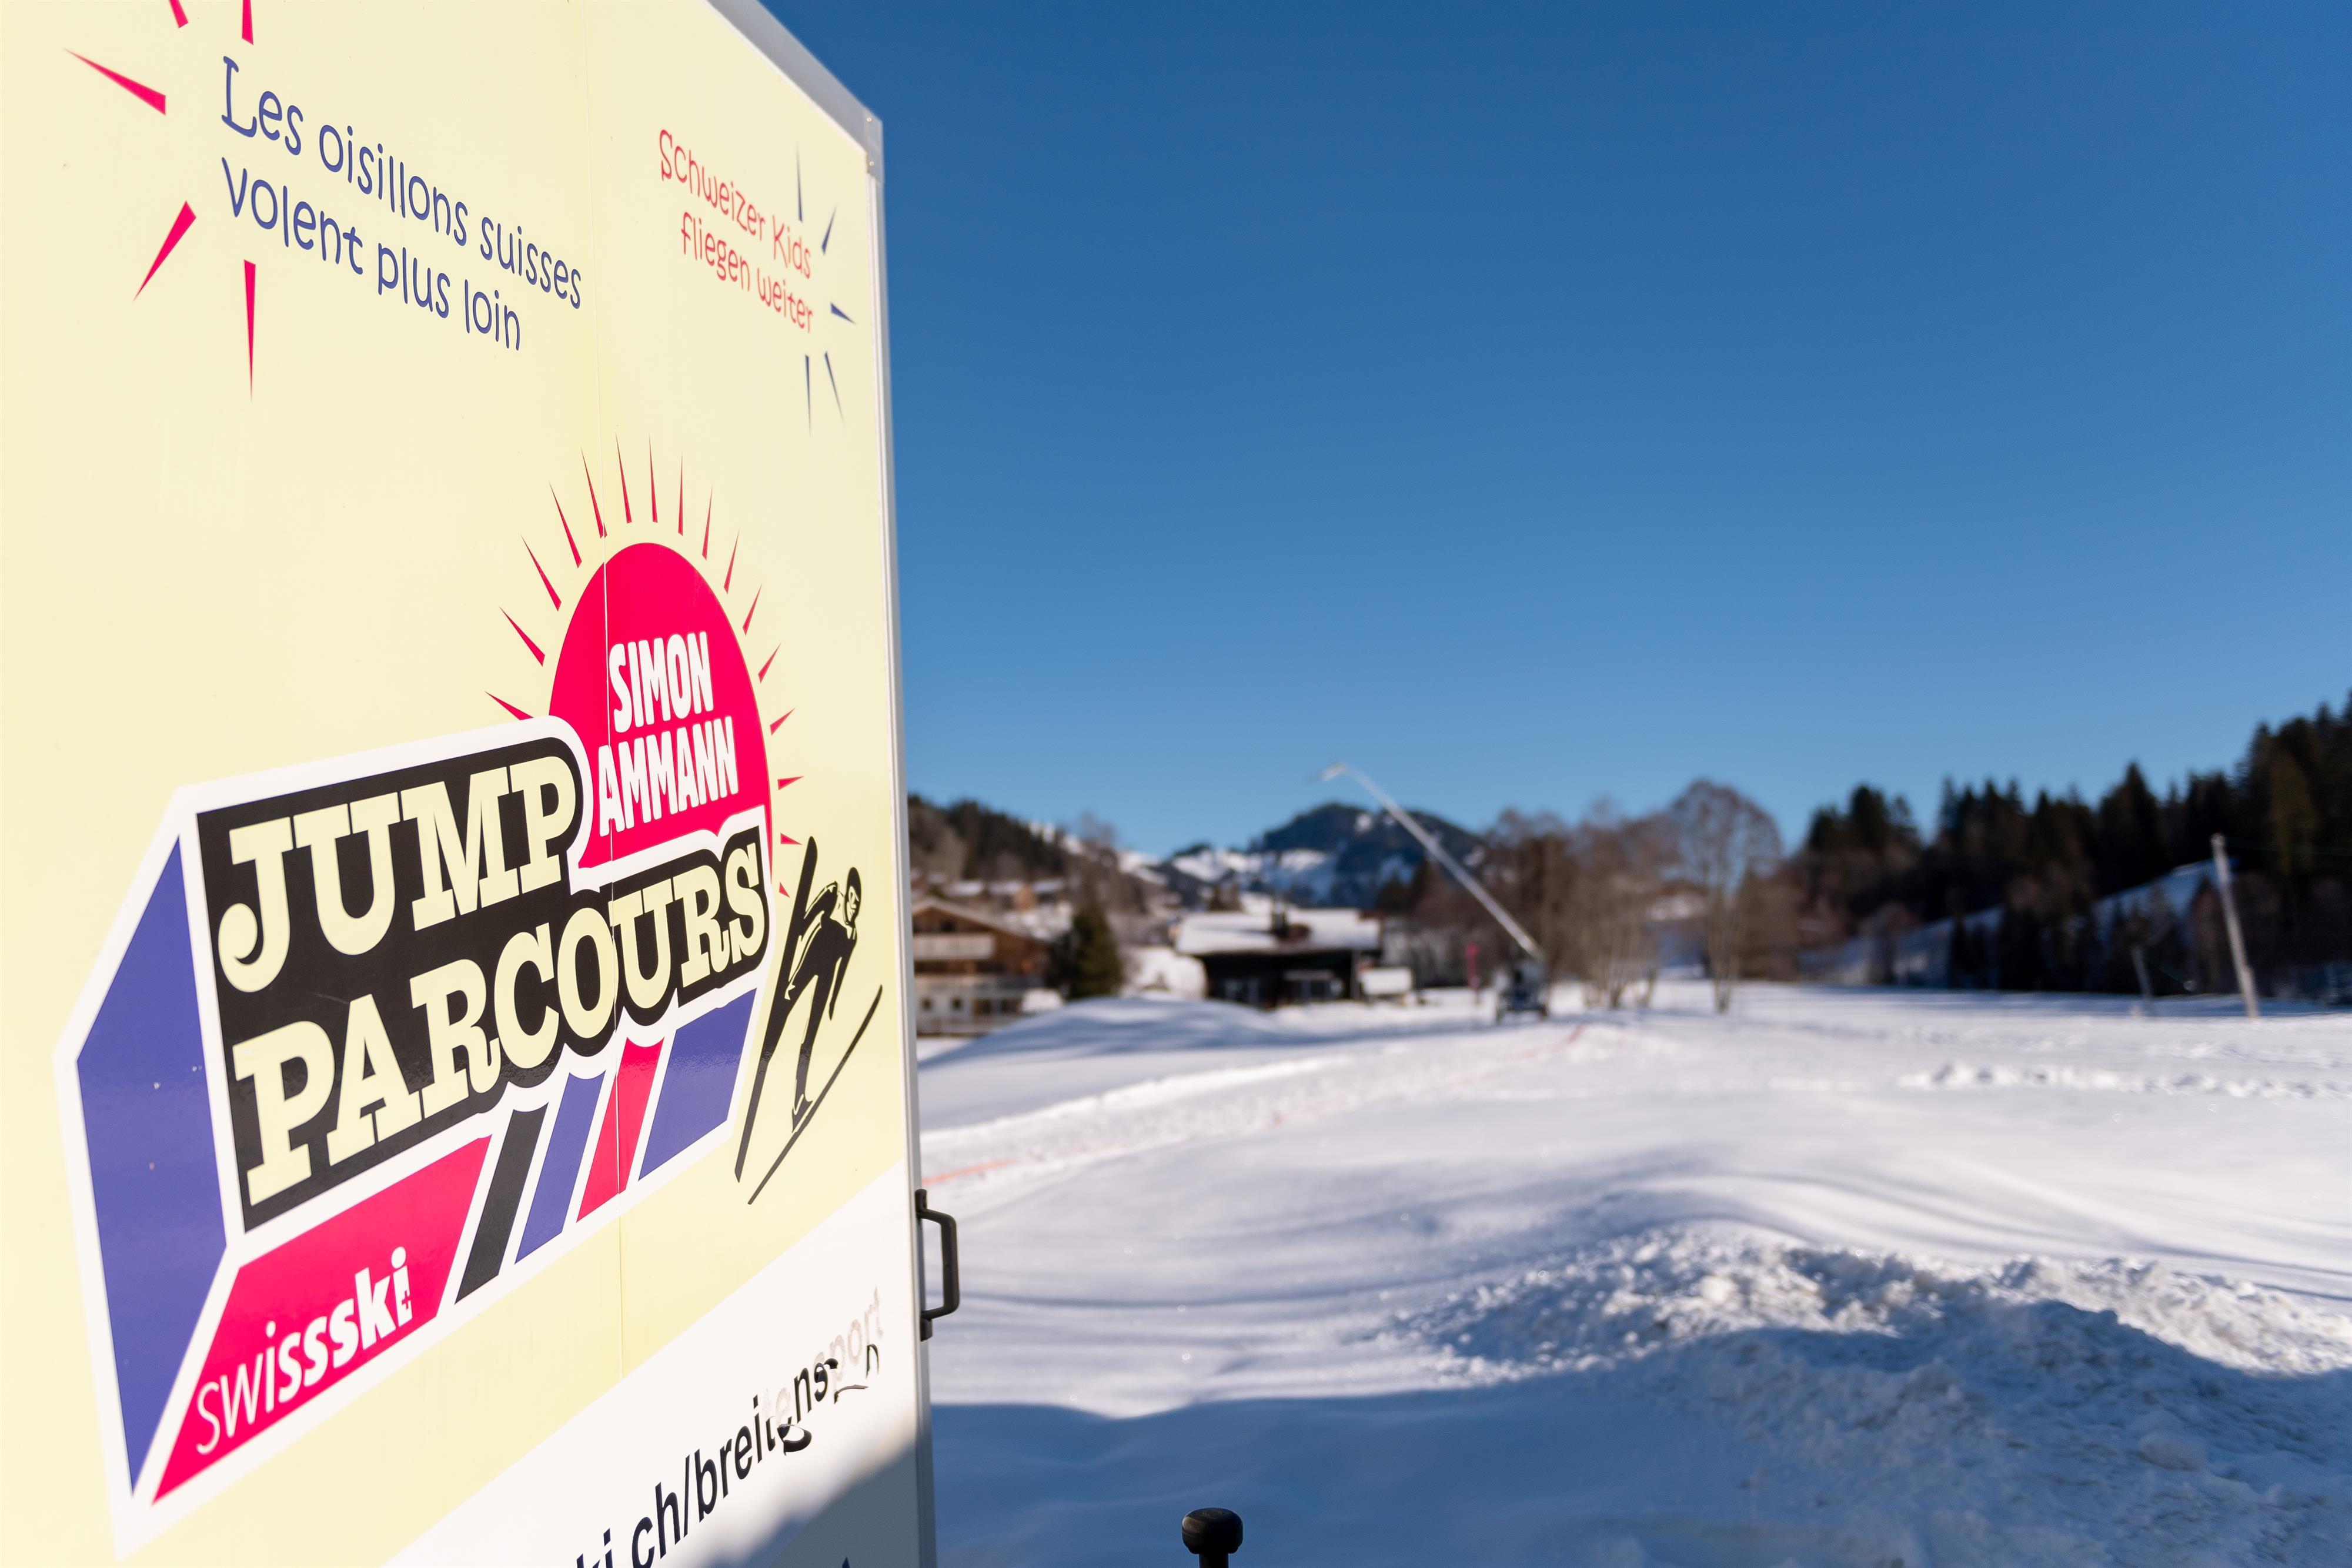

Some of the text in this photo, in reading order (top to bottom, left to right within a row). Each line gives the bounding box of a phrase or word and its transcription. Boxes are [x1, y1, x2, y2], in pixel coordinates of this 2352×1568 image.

[221, 56, 582, 309] Les oisillons suisses
[221, 156, 521, 351] volent plus loin
[659, 129, 813, 280] Schweizer Kids
[681, 211, 814, 334] fliegen weiter
[598, 716, 739, 837] AMMANN
[609, 631, 714, 733] SIMON
[218, 755, 576, 993] JUMP
[233, 842, 766, 1206] PARCOURS
[196, 1246, 413, 1455] swissski
